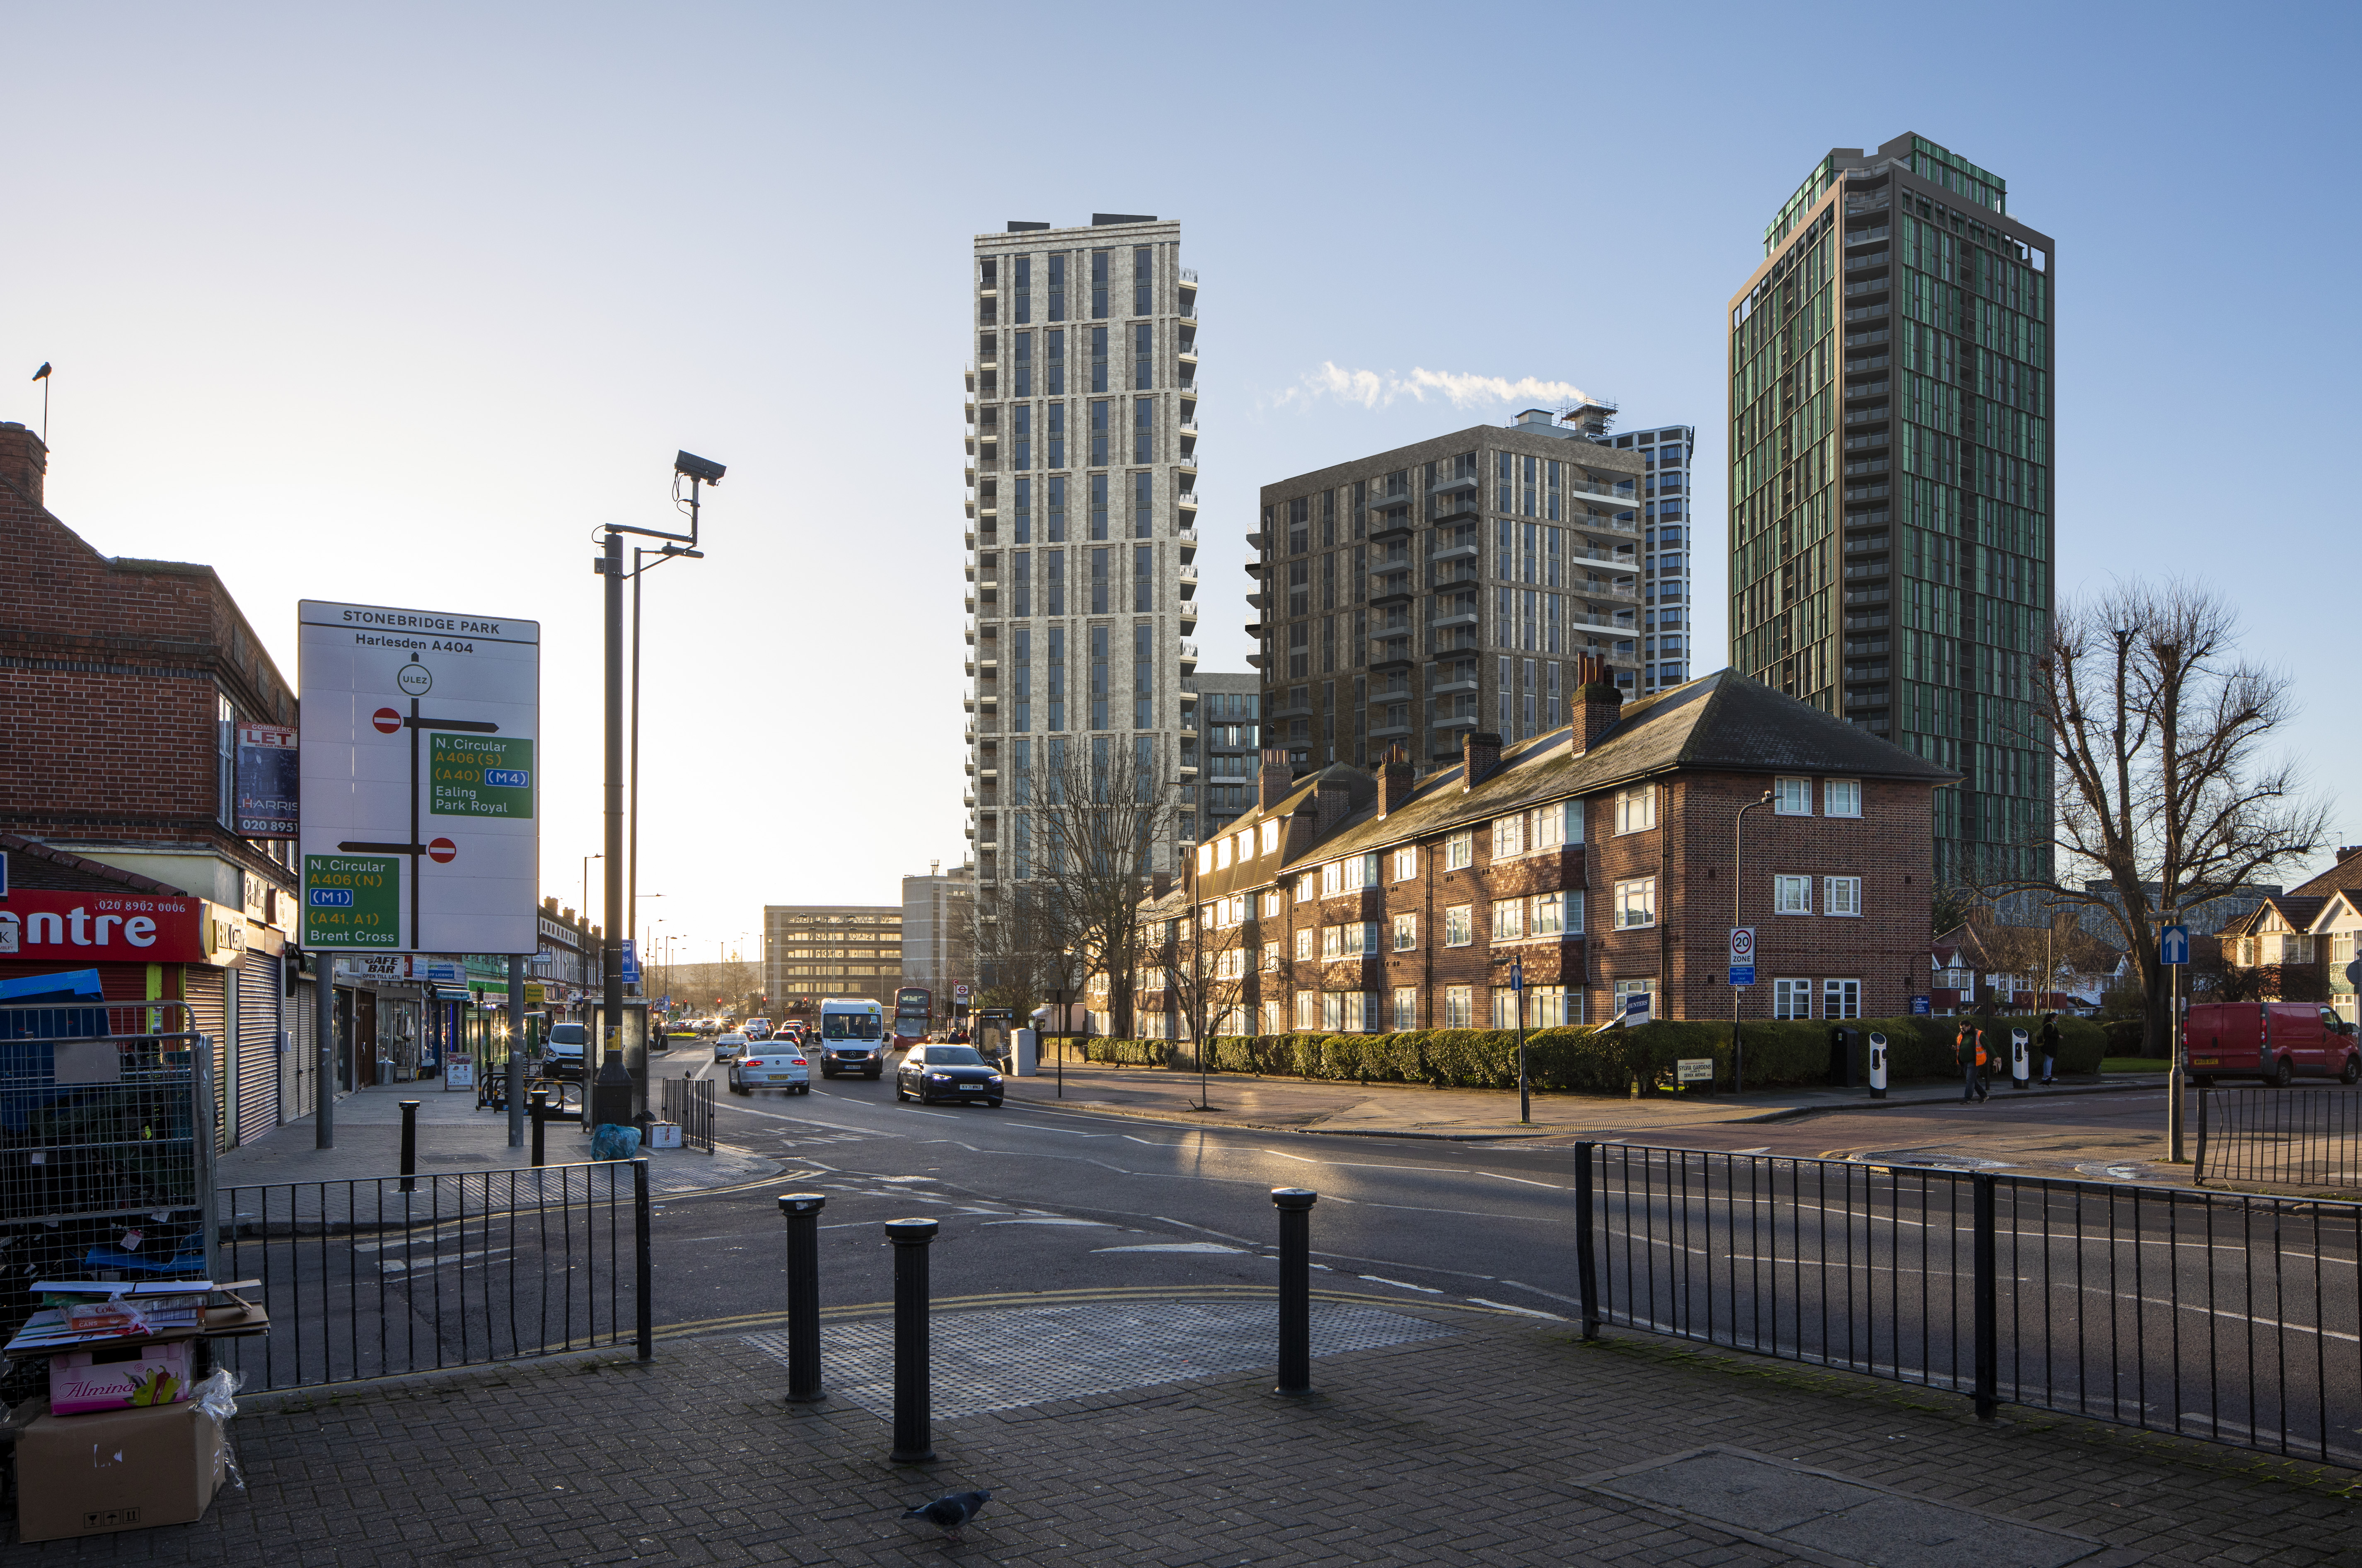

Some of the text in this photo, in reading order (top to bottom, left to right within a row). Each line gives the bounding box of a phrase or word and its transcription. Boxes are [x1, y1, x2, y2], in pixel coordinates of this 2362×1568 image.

[343, 610, 500, 634] STONEBRIDGE PARK
[356, 634, 473, 653] Harlesden A404
[403, 676, 427, 684] ULEZ
[247, 730, 291, 745] LET
[436, 737, 506, 752] N. Circular
[435, 751, 501, 766] A406 (S)
[435, 767, 526, 785] (A40) (M4)
[436, 786, 476, 800] Ealing
[436, 799, 508, 814] Park Royal
[243, 819, 267, 831] 020
[311, 860, 385, 872] N. Circular
[310, 874, 382, 887] A406 (N)
[313, 891, 350, 904] (M1)
[99, 901, 185, 912] 020 8902 0006
[353, 913, 379, 926] A1)
[311, 930, 394, 942] Brent Cross
[1736, 937, 1749, 947] 20
[368, 965, 395, 973] BAR
[1627, 1000, 1648, 1009] HUNTERS
[95, 1305, 118, 1314] Coke
[57, 1380, 136, 1399] Almina
